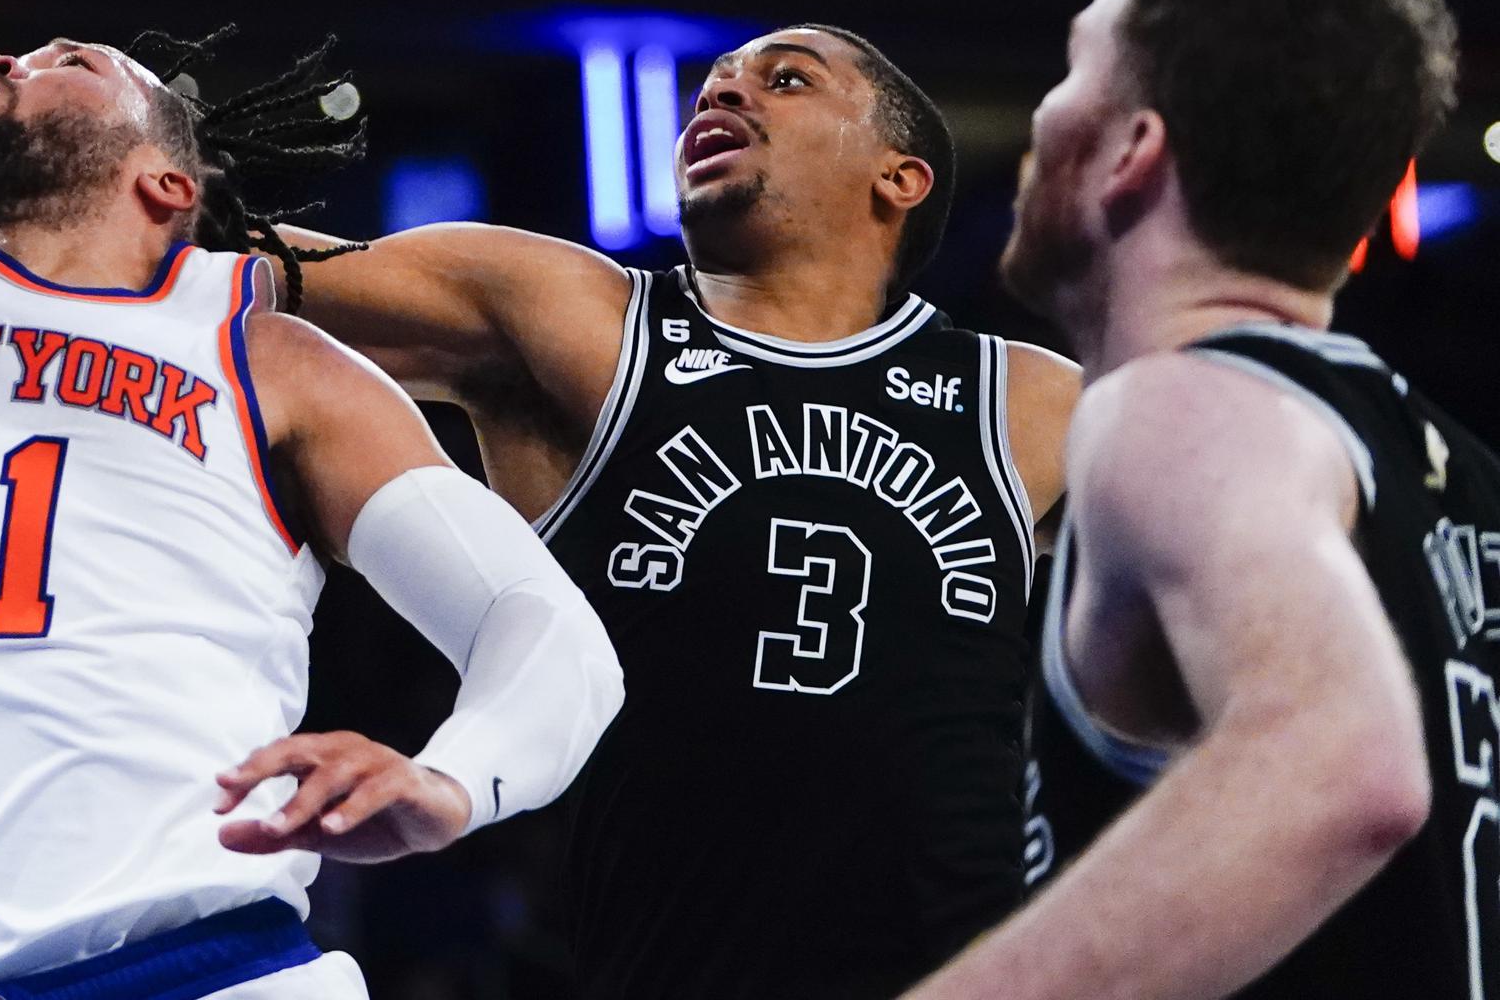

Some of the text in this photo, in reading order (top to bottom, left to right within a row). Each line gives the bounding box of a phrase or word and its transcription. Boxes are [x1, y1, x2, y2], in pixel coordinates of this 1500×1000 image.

[661, 318, 690, 343] 6
[677, 348, 732, 370] NIKE
[5, 326, 218, 464] YORK
[885, 367, 964, 413] Self.
[607, 403, 996, 623] SAN ANTONIO
[753, 517, 872, 695] 3
